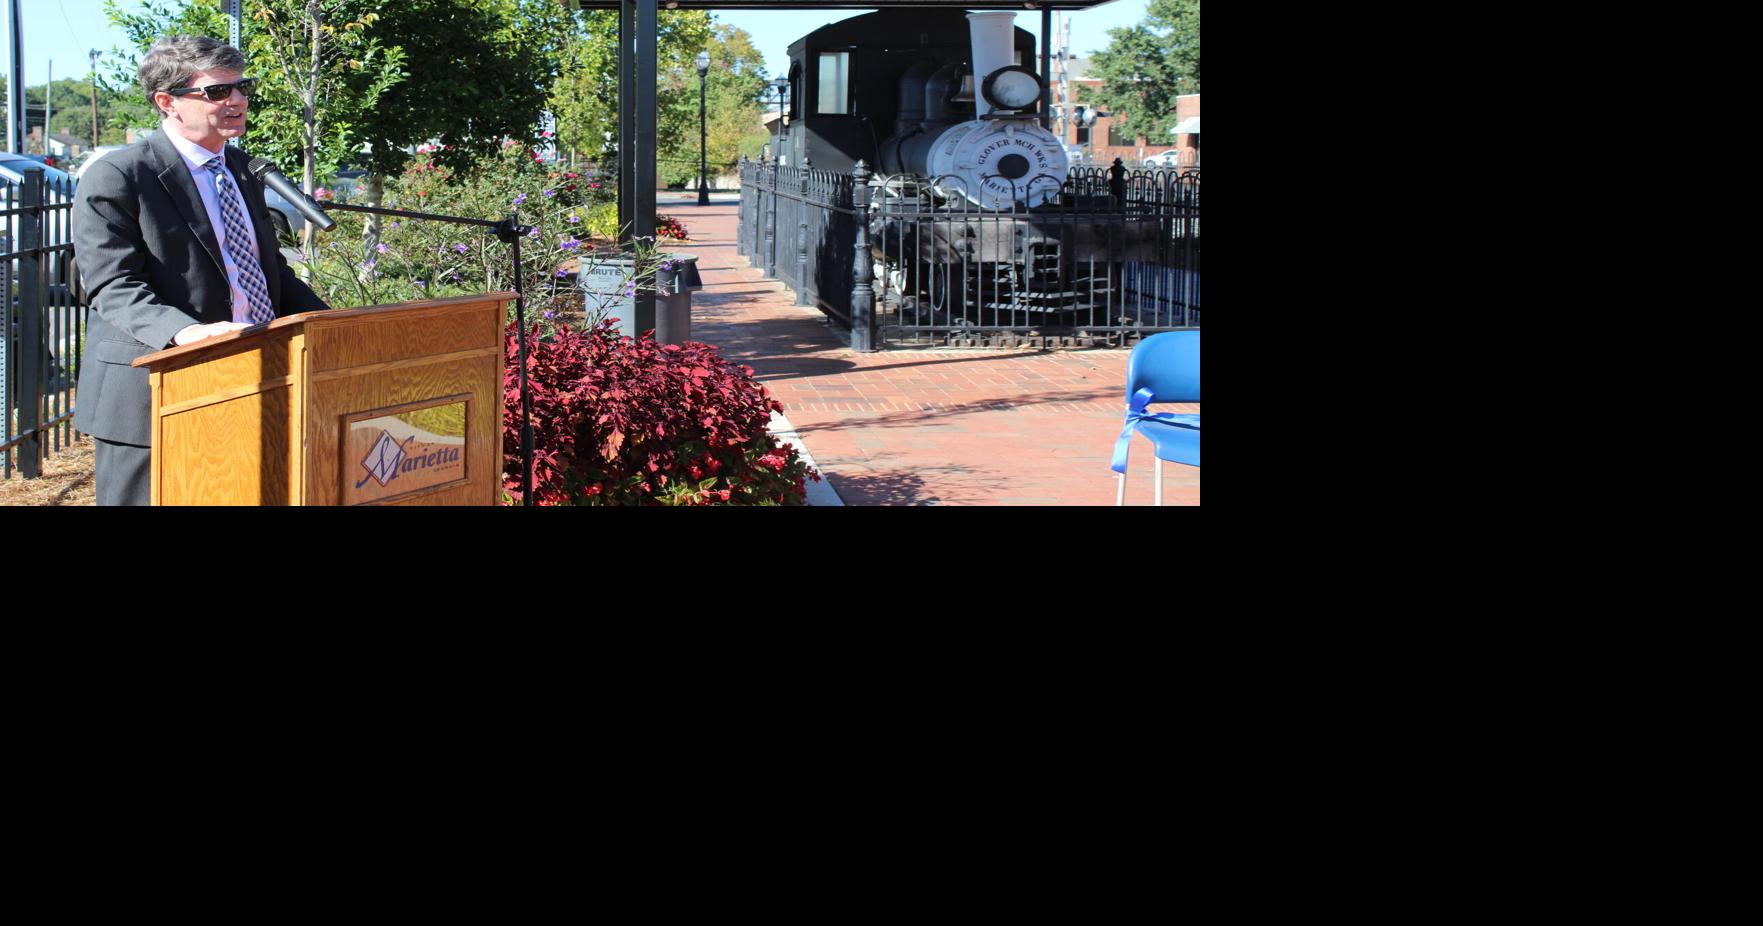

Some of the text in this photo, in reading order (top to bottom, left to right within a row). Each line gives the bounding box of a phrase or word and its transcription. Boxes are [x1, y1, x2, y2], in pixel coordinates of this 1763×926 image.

[978, 138, 1048, 169] GLOVER MCH WKS
[979, 172, 1033, 194] MARIET
[356, 435, 460, 488] Marietta
